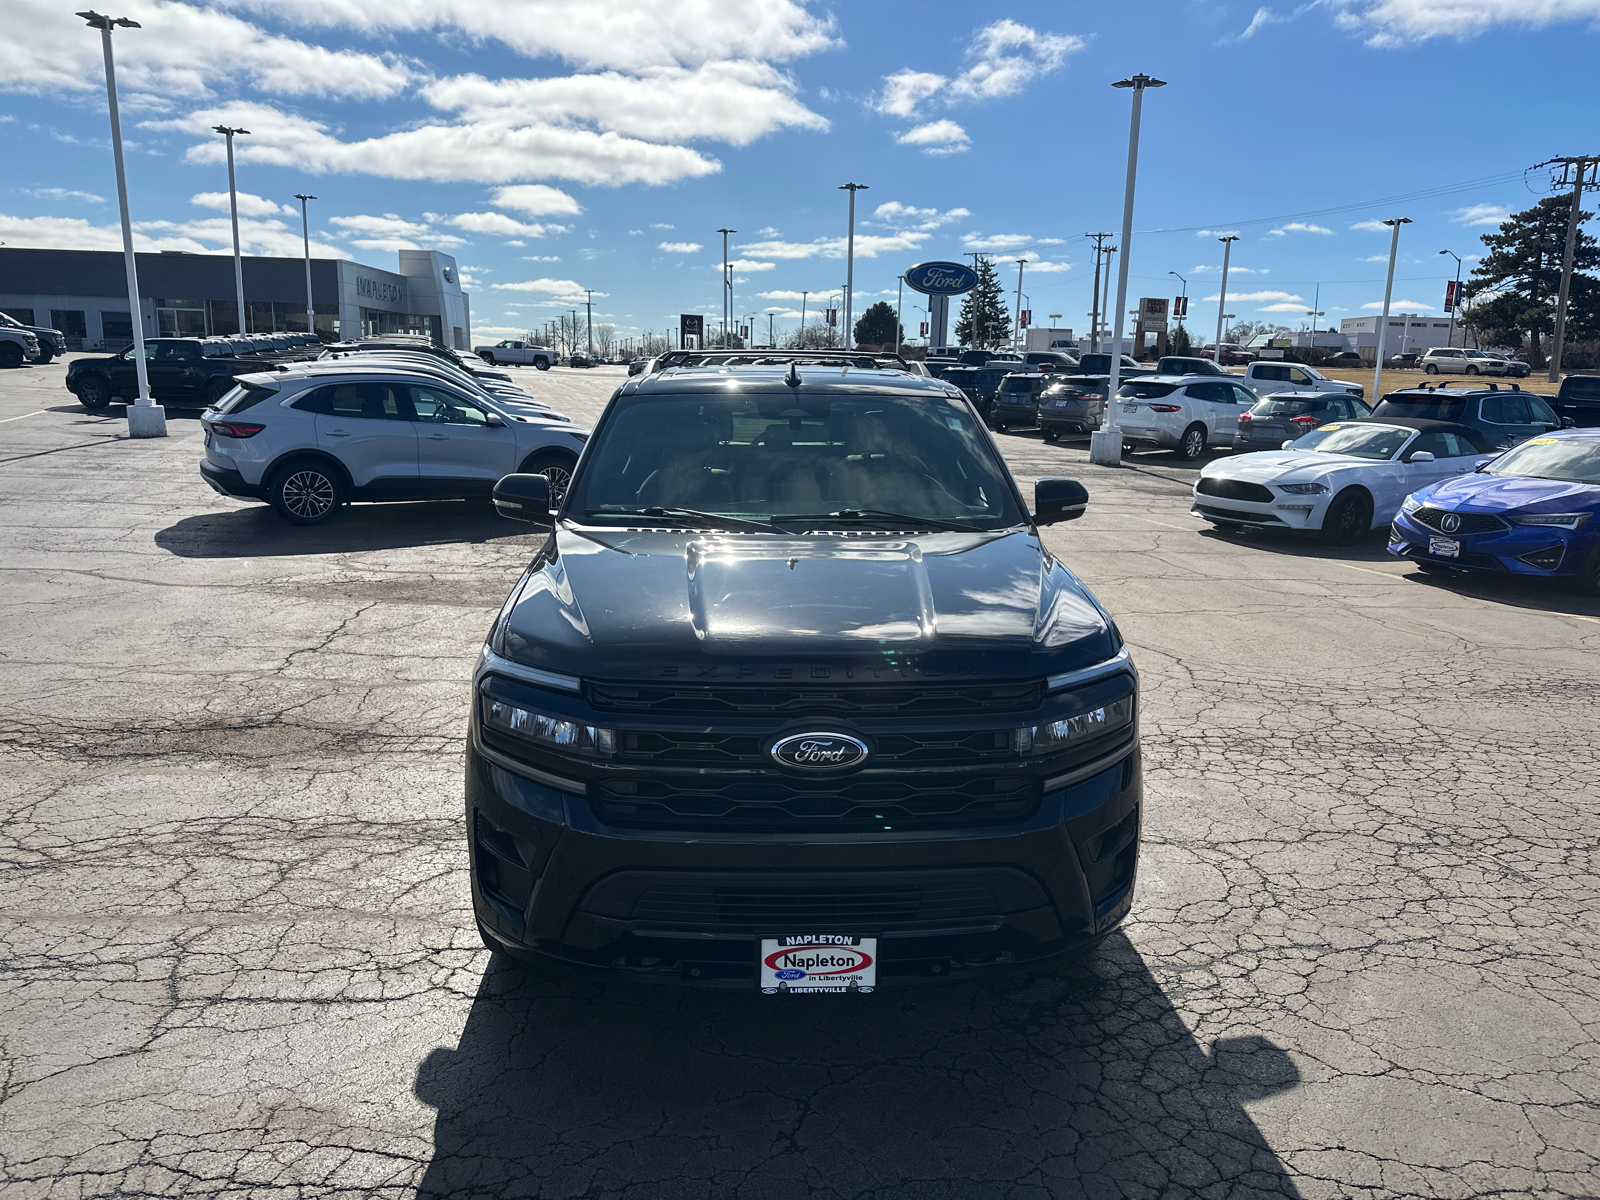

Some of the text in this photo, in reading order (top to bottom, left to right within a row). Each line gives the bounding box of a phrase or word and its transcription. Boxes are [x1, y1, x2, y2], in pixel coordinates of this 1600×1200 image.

[923, 267, 965, 288] Ford
[356, 276, 404, 304] NAPLETON
[659, 664, 978, 679] EXPEDITION
[794, 740, 846, 762] Ford
[786, 935, 853, 945] NAPLETON
[783, 954, 854, 970] Napleton
[781, 970, 801, 979] Ford
[819, 974, 863, 982] Libertyville
